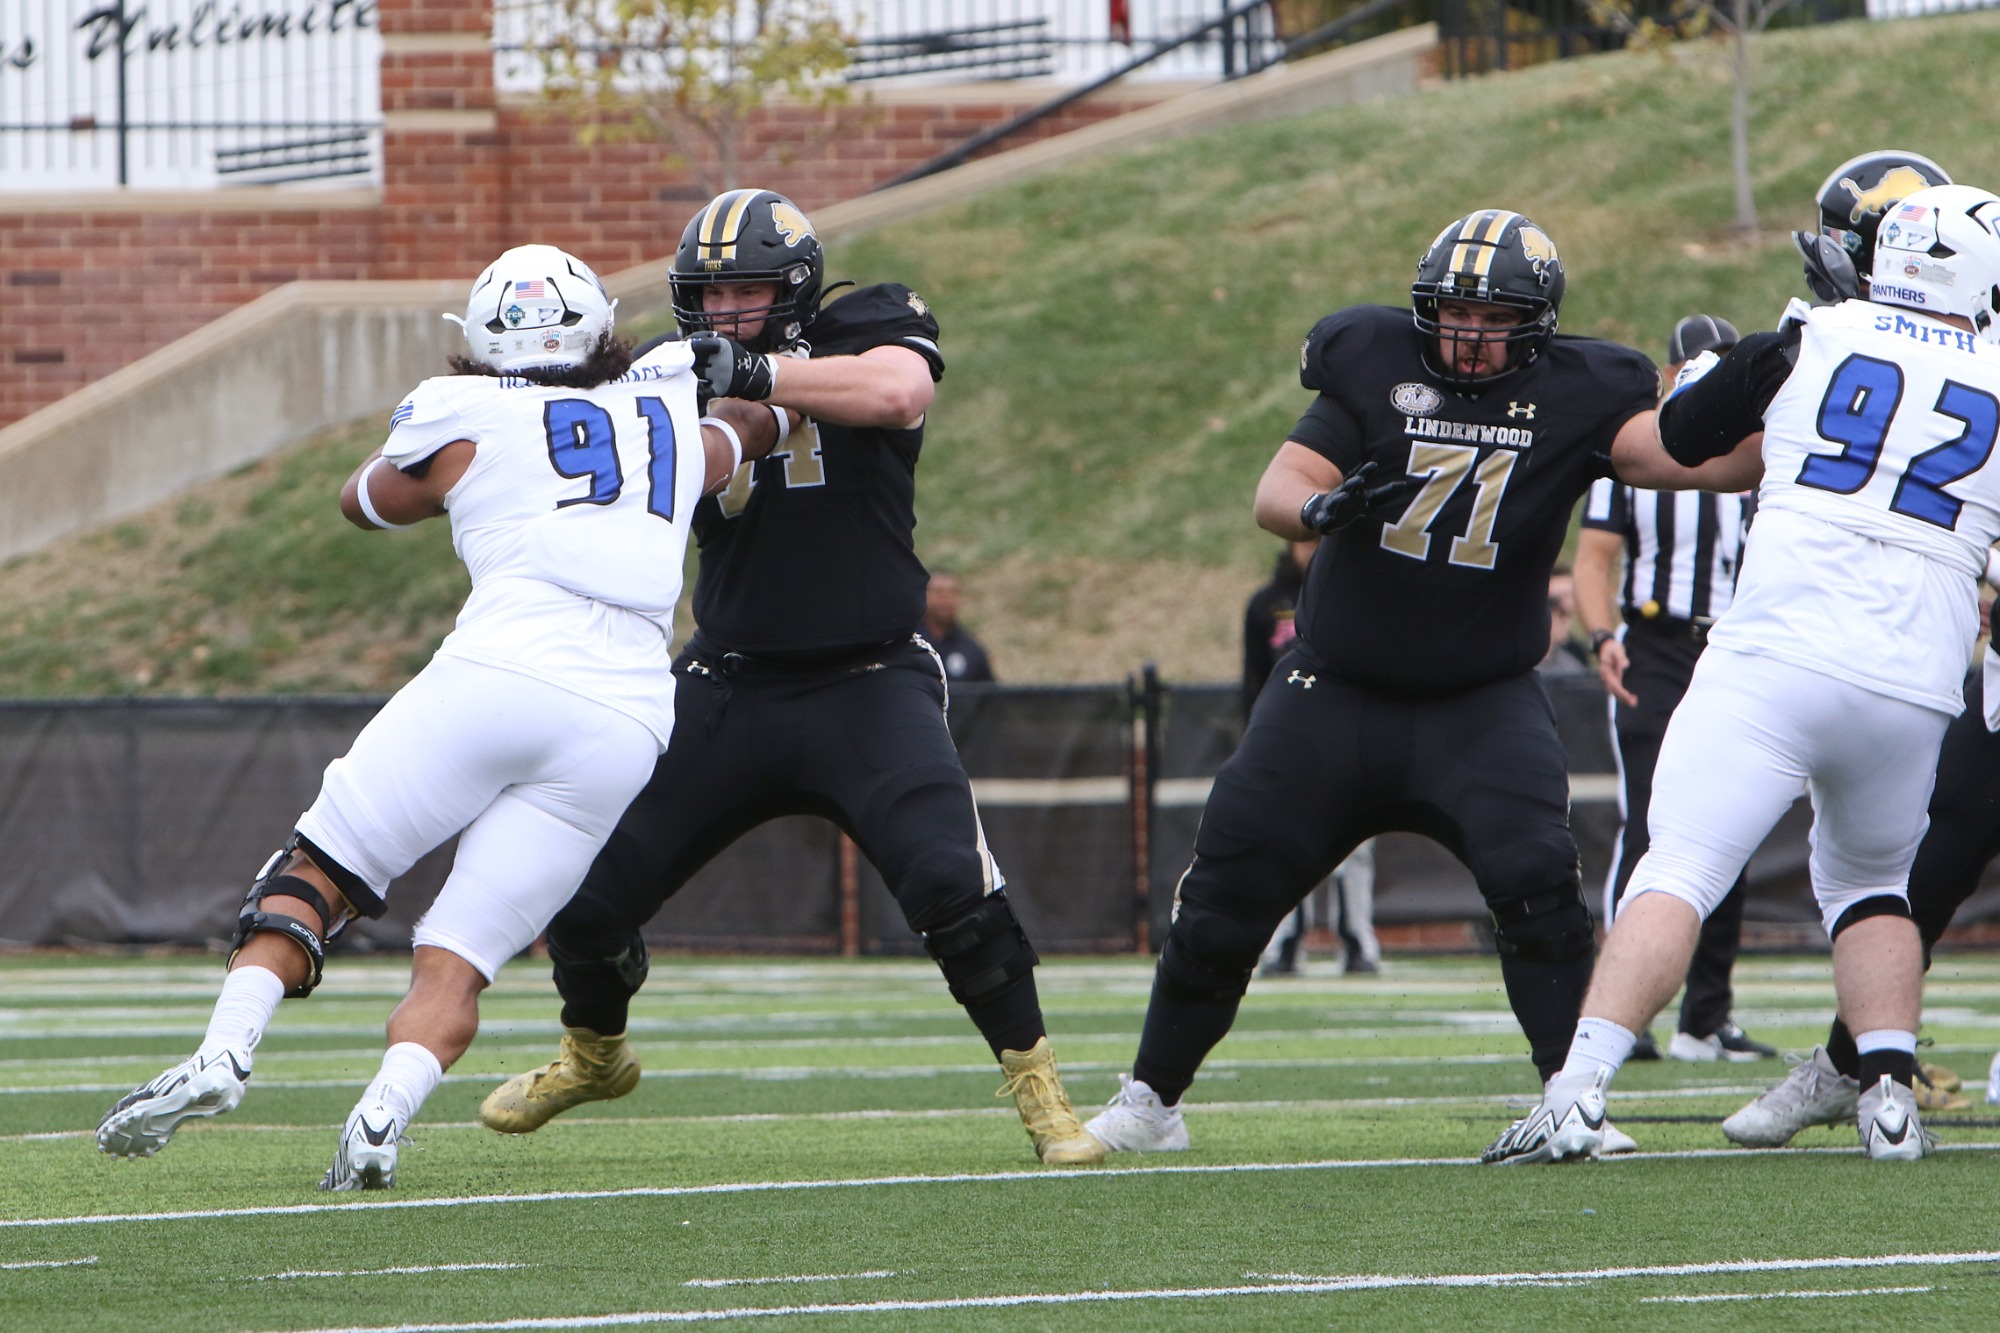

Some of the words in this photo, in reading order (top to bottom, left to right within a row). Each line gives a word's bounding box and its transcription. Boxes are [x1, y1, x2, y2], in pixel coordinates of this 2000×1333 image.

[1873, 284, 1926, 304] PANTHERS
[1875, 315, 1976, 354] SMITH
[1402, 391, 1432, 406] OVC
[1405, 416, 1533, 448] LINDENWOOD
[1795, 352, 2000, 532] 92
[543, 396, 677, 524] 91
[1380, 440, 1519, 570] 71
